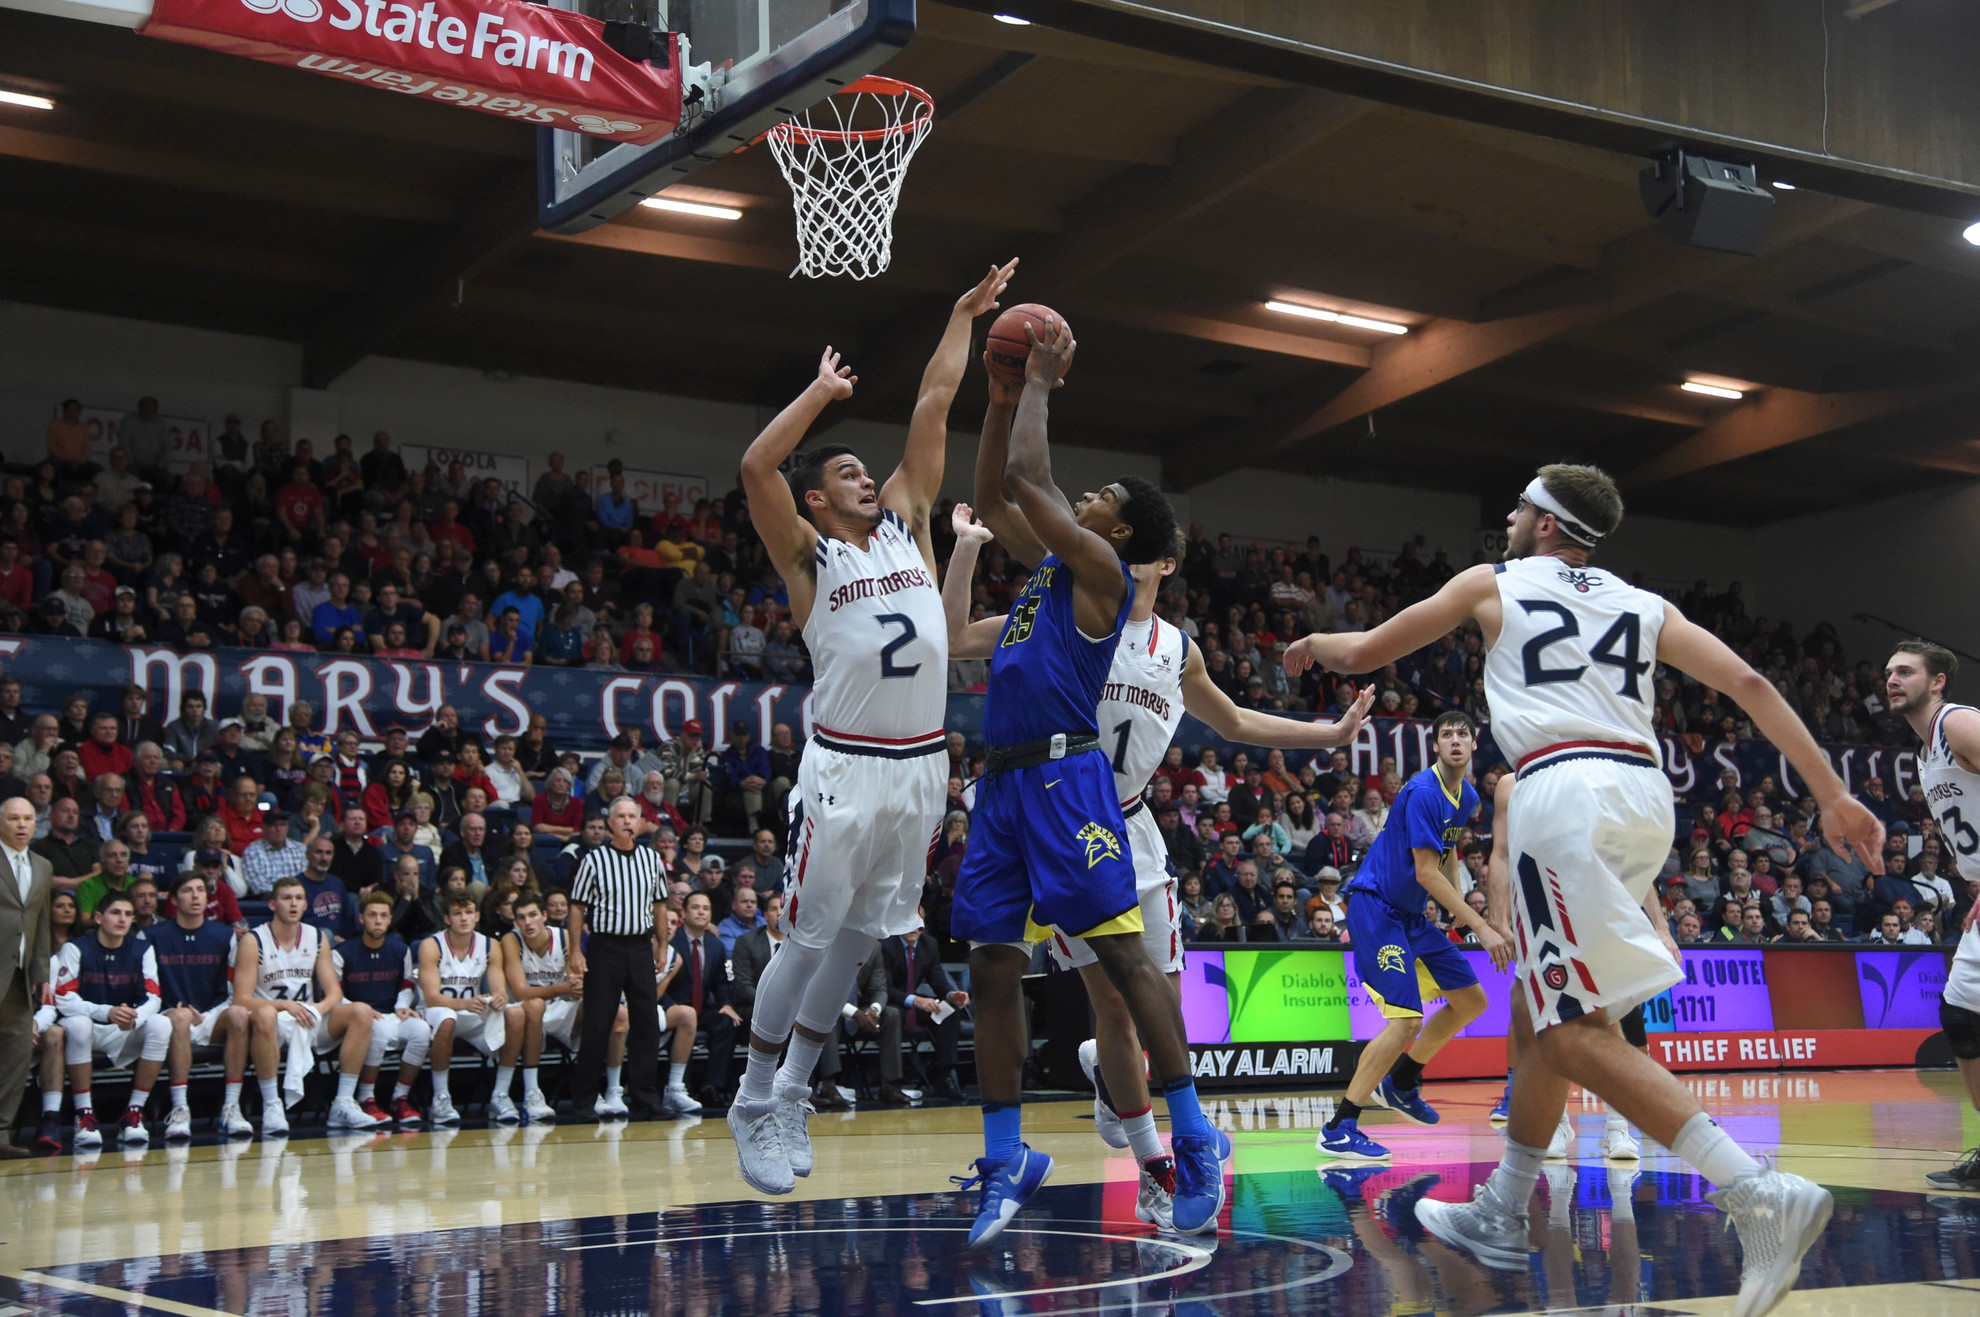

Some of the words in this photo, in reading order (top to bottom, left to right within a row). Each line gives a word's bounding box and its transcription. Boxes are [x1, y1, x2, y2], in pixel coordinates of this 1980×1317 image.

[596, 475, 702, 505] PCIFIC
[829, 578, 875, 612] SAINT
[872, 613, 922, 679] 2
[1515, 599, 1651, 705] 24
[123, 645, 532, 741] MARY'S
[600, 674, 816, 752] COLL
[1126, 685, 1171, 721] MARY'S
[1112, 718, 1133, 775] 1
[1281, 974, 1335, 989] Diablo
[1686, 959, 1698, 985] A
[1283, 993, 1360, 1008] Insurance
[1234, 1047, 1333, 1077] ALARM
[1660, 1039, 1728, 1063] THIEF
[1739, 1037, 1817, 1060] RELIEF
